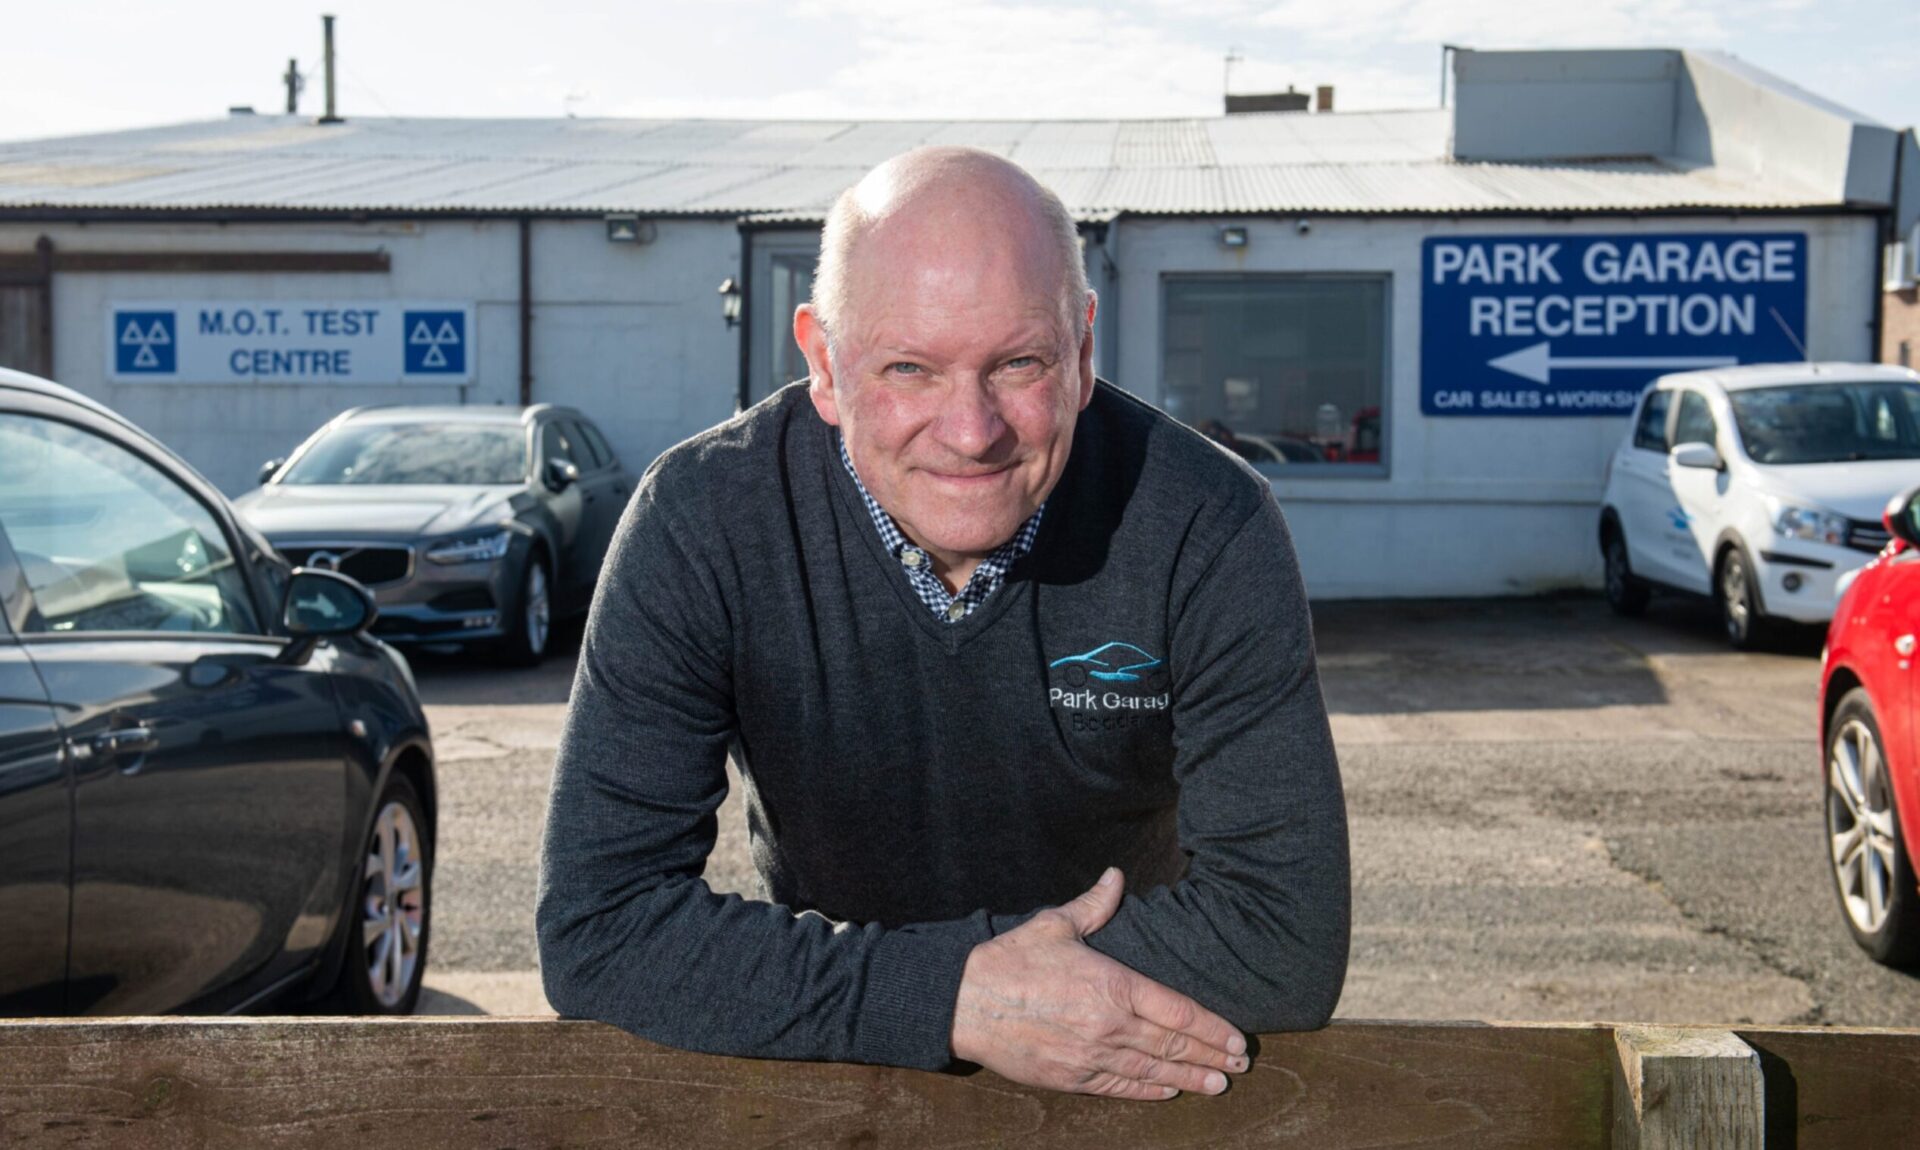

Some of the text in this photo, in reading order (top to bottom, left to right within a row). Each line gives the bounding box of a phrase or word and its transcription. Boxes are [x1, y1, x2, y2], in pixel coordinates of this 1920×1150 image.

[1433, 240, 1796, 285] PARK GARAGE
[198, 309, 379, 336] M.O.T. TEST
[1470, 294, 1756, 336] RECEPTION
[229, 348, 352, 375] CENTRE
[1435, 389, 1641, 409] CAR SALES WORKSH
[1049, 688, 1170, 710] Park Garag
